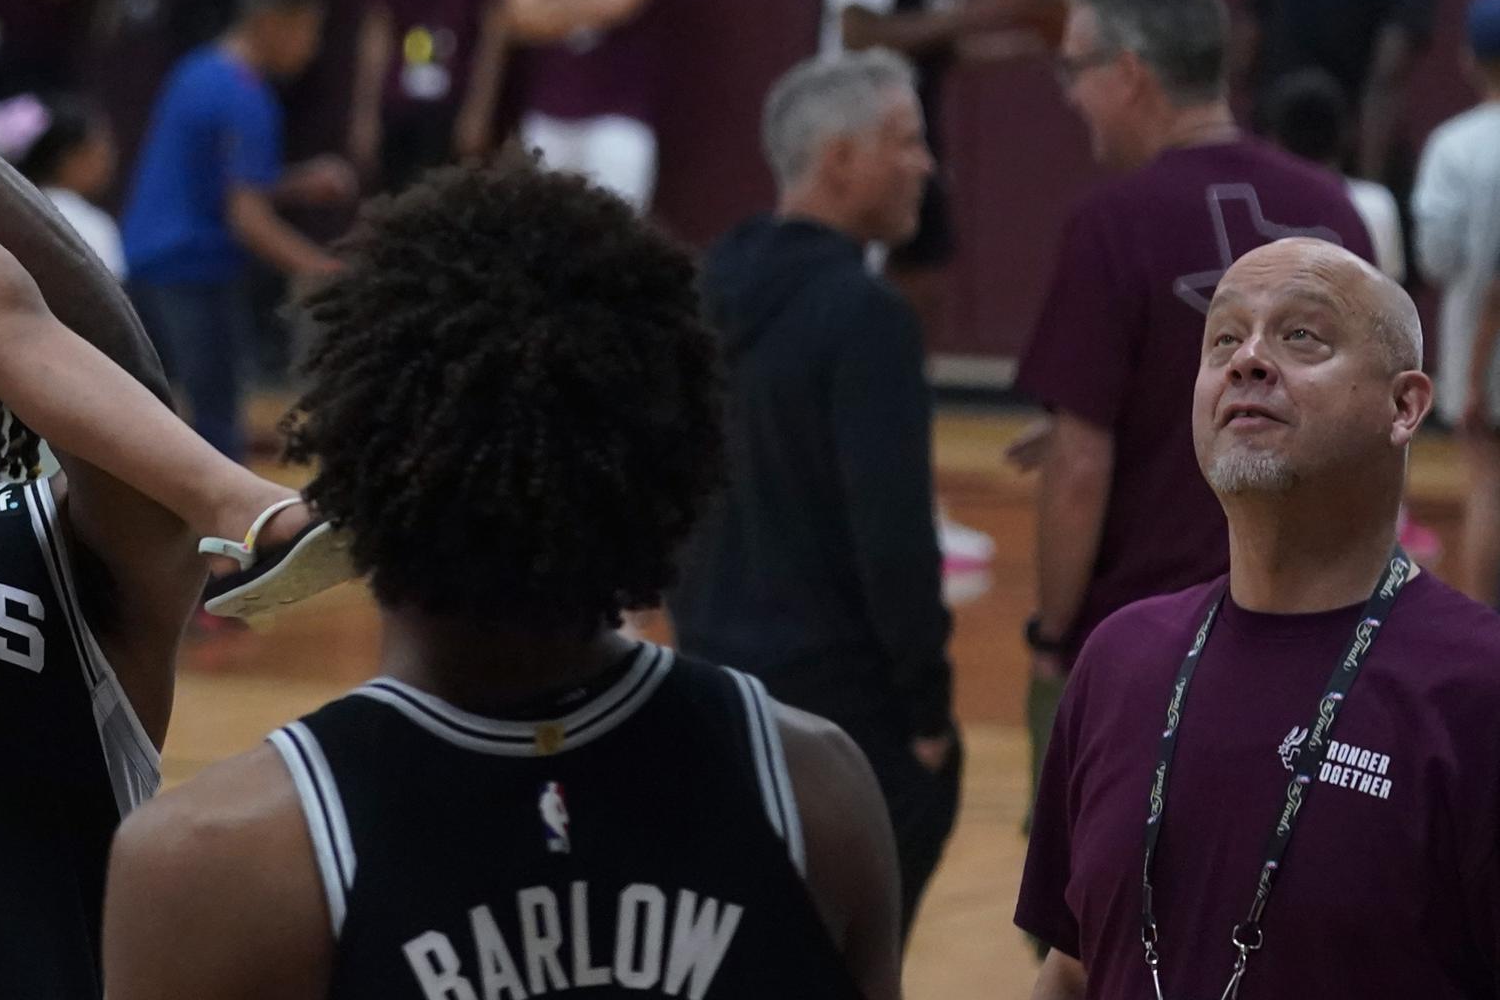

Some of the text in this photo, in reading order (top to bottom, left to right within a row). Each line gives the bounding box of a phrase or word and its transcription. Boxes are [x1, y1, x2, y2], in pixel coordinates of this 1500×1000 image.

[1327, 739, 1391, 776] RONGER
[1318, 760, 1392, 799] OGETHER
[403, 881, 744, 1000] BARLOW
